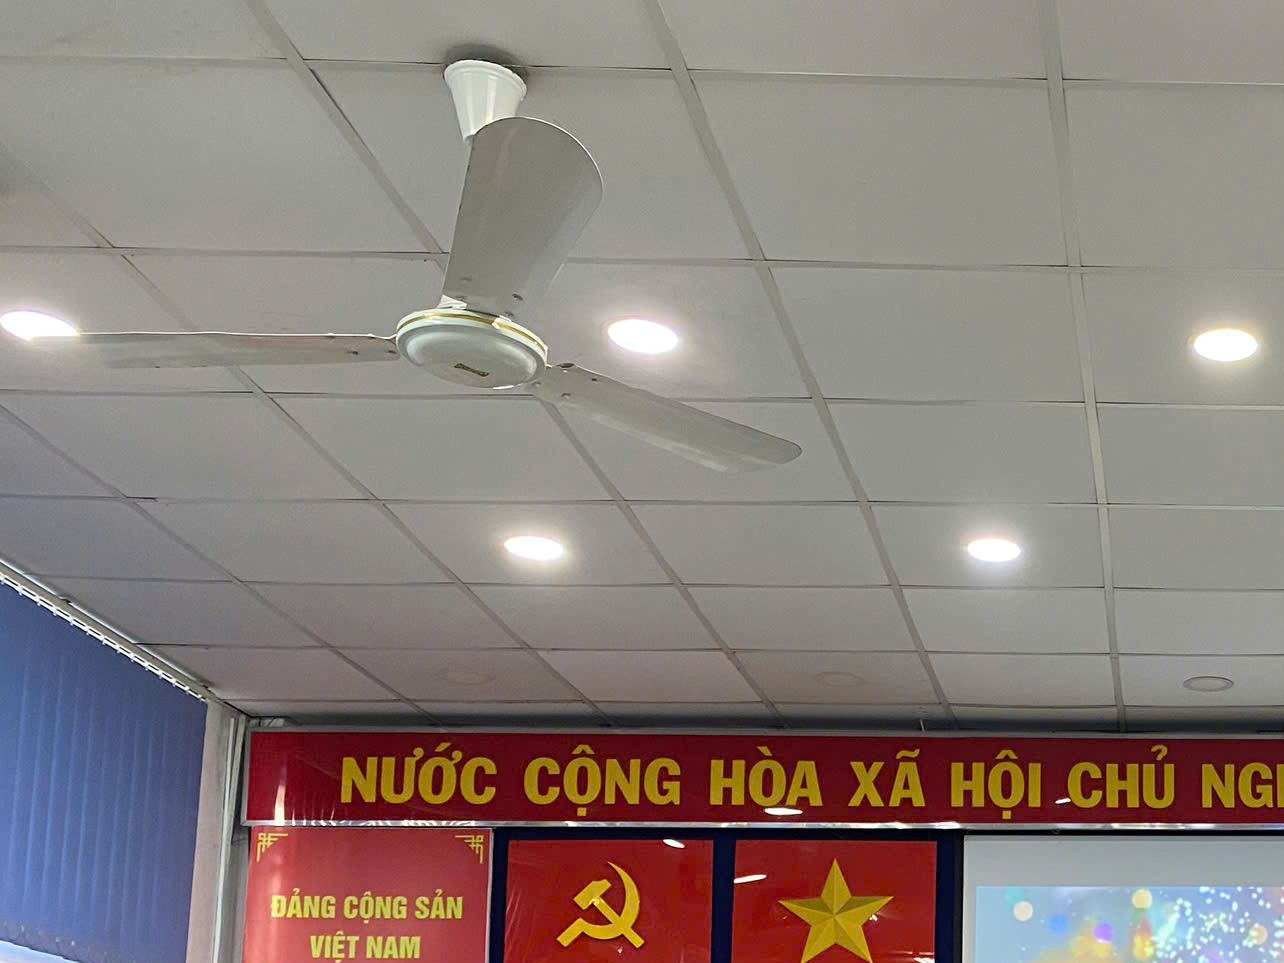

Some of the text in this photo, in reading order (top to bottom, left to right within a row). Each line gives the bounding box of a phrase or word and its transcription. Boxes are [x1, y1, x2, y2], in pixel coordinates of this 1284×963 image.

[341, 743, 496, 804] NƯỚC
[524, 745, 680, 816] CỘNG
[710, 746, 822, 806] HÒA
[848, 749, 925, 807] XÃ
[951, 750, 1041, 819] HỘI
[1068, 745, 1174, 808] CHỦ
[271, 888, 464, 924] ĐẢNG CỘNG SẢN
[310, 931, 421, 962] VIỆT NAM
